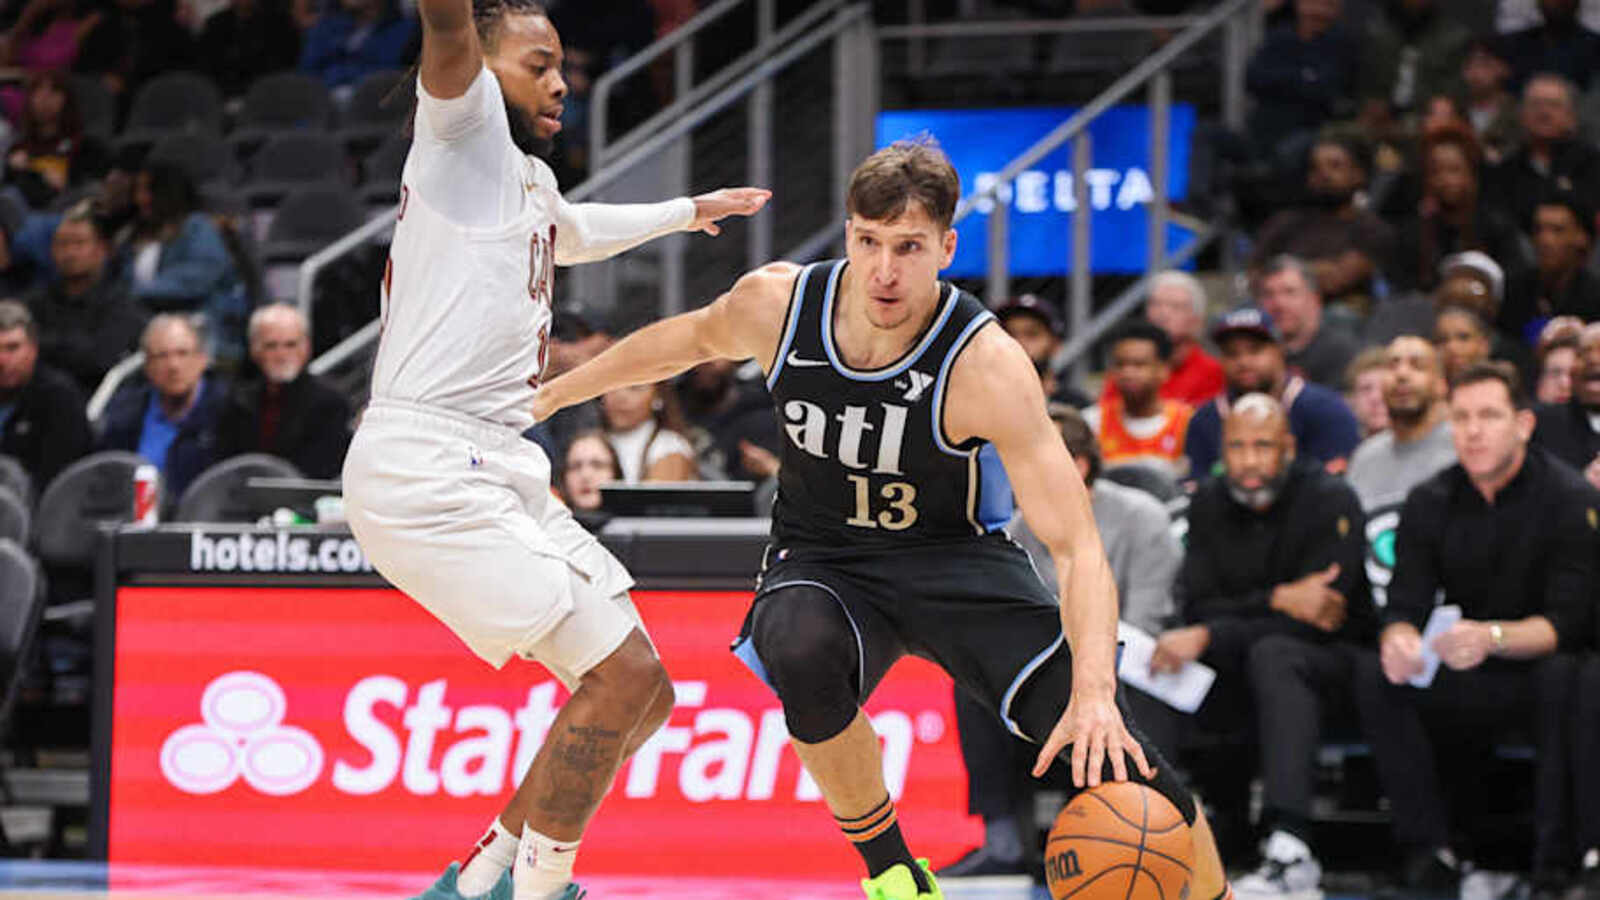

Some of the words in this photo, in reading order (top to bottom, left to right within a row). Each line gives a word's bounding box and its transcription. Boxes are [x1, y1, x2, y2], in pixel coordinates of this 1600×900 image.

[974, 167, 1156, 214] DELTA
[784, 400, 908, 476] atl
[845, 475, 919, 531] 13
[331, 674, 562, 798] Stat
